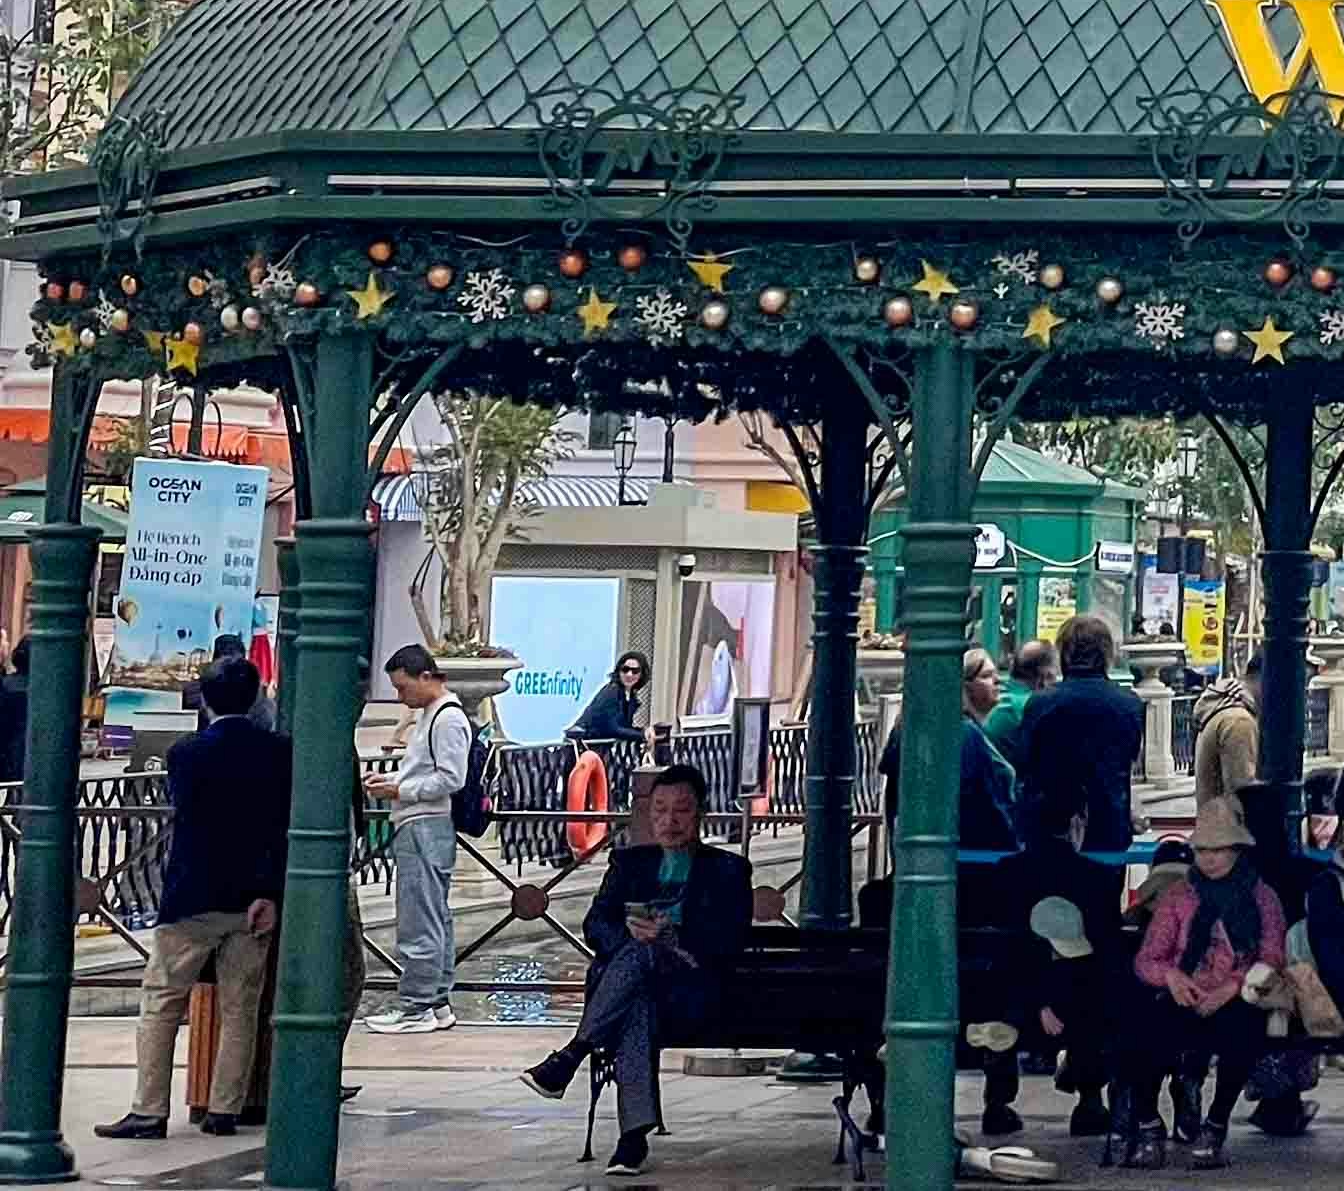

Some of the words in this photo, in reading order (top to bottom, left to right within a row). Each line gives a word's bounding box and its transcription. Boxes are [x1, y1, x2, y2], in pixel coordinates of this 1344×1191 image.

[148, 477, 202, 491] OCEAN
[157, 491, 192, 504] CITY
[131, 546, 208, 566] All-in-One
